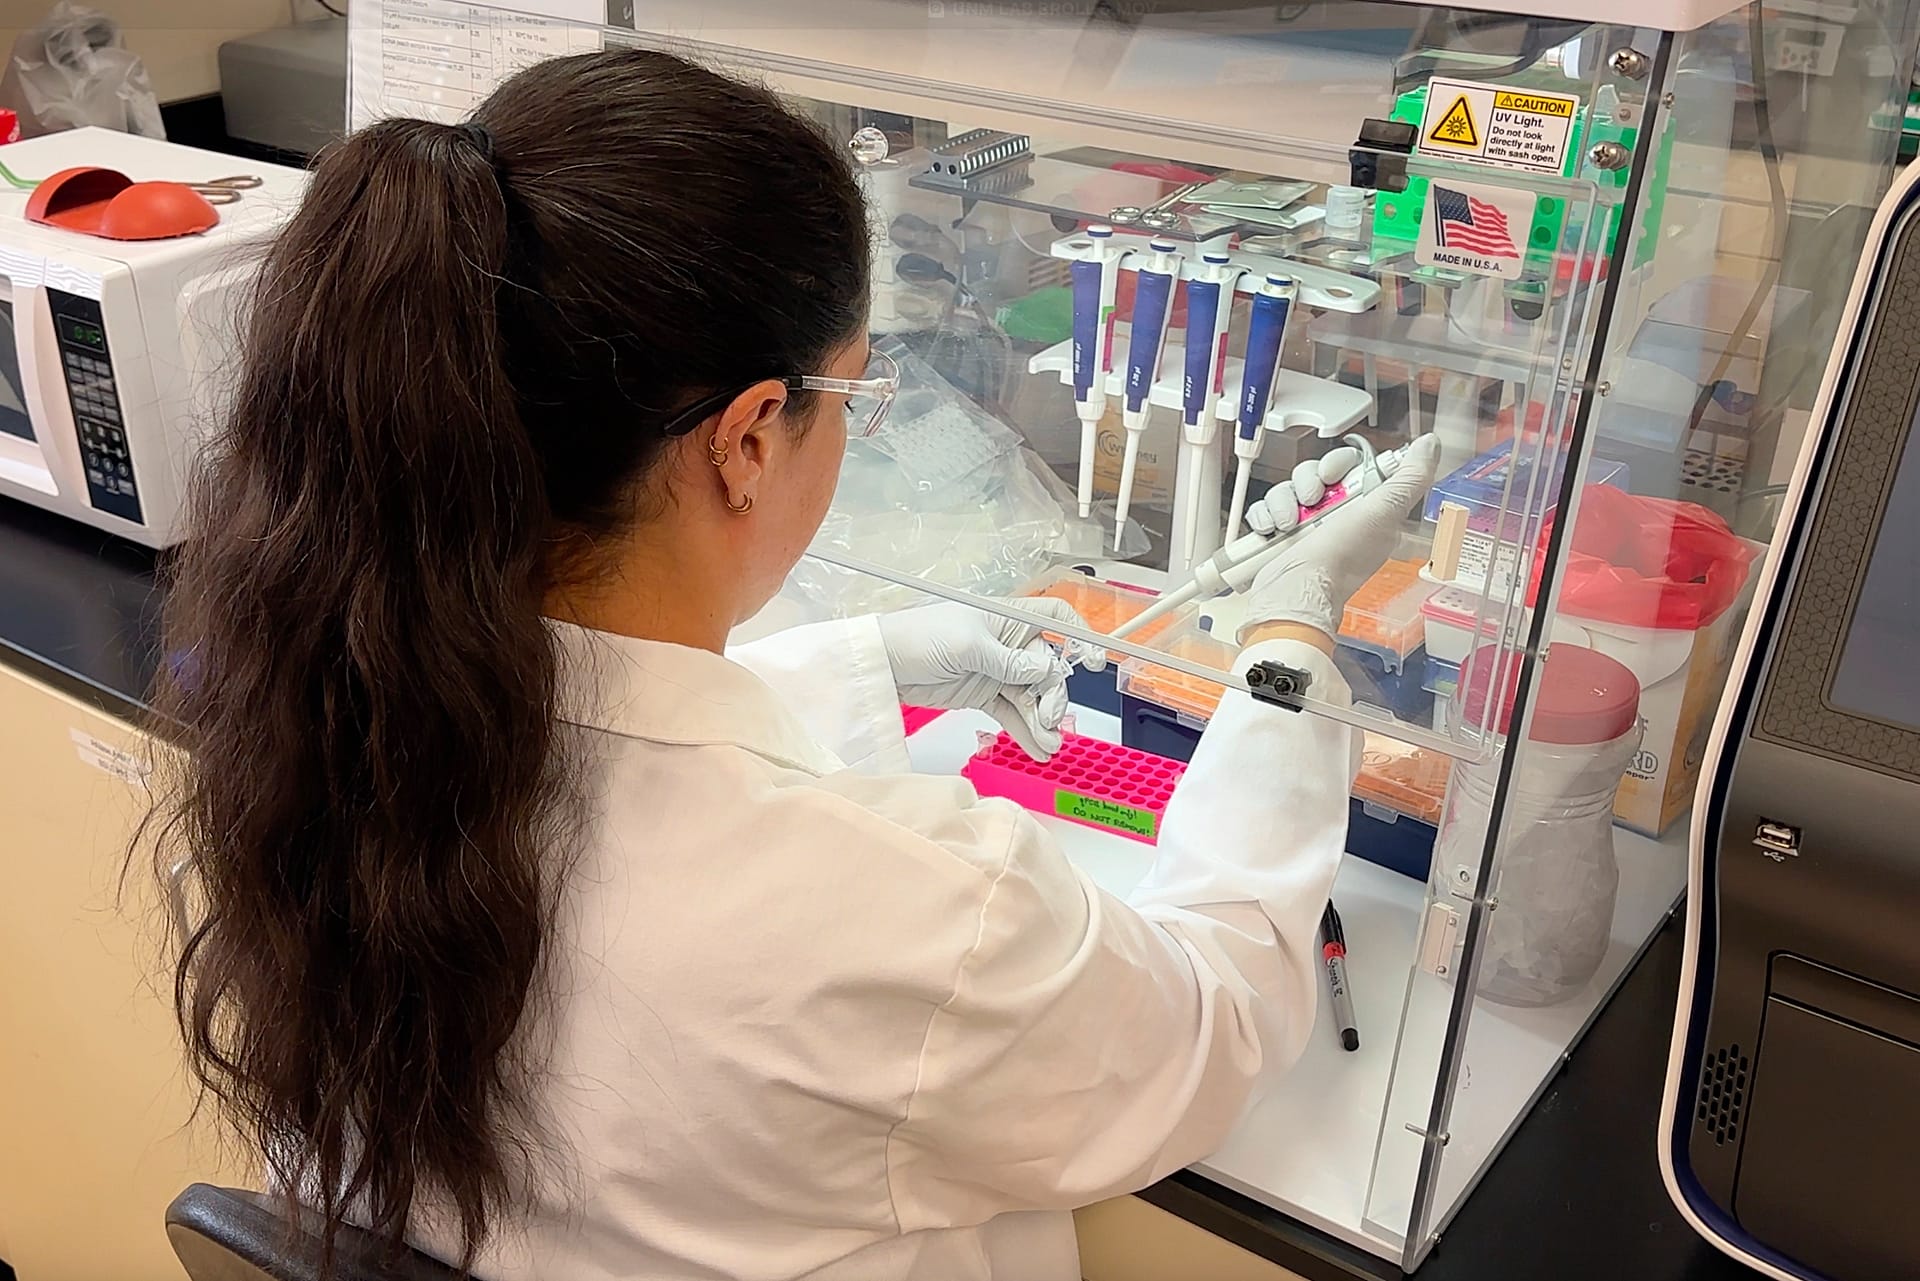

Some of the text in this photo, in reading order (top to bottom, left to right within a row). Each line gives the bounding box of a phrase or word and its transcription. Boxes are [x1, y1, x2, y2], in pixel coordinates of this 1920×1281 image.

[1514, 97, 1566, 113] CAUTION
[1495, 112, 1543, 128] UV Light.
[1492, 126, 1542, 141] Do not look
[1490, 137, 1555, 154] directly at light
[1488, 146, 1556, 164] with sash open.
[1433, 252, 1502, 272] MADE IN U.S.A.
[1073, 806, 1086, 817] DO
